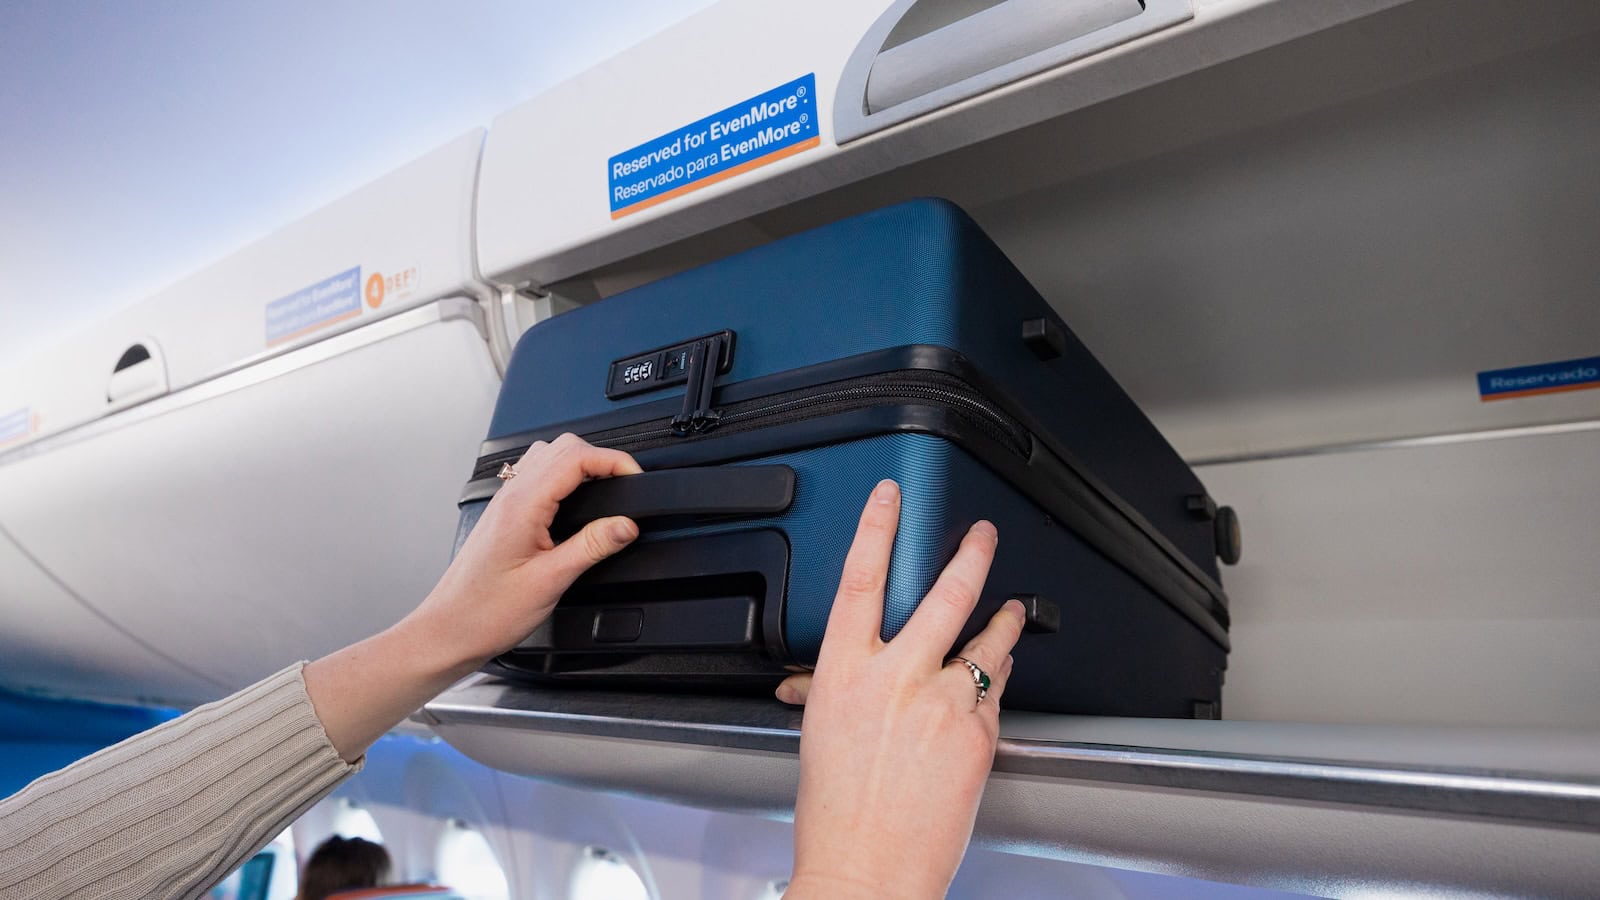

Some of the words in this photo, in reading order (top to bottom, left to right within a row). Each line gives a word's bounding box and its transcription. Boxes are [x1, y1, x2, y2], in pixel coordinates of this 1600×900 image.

[613, 139, 681, 180] Reserved
[683, 129, 708, 152] for
[614, 165, 684, 202] Reservado
[686, 152, 718, 179] para
[1490, 367, 1598, 389] Reservado
